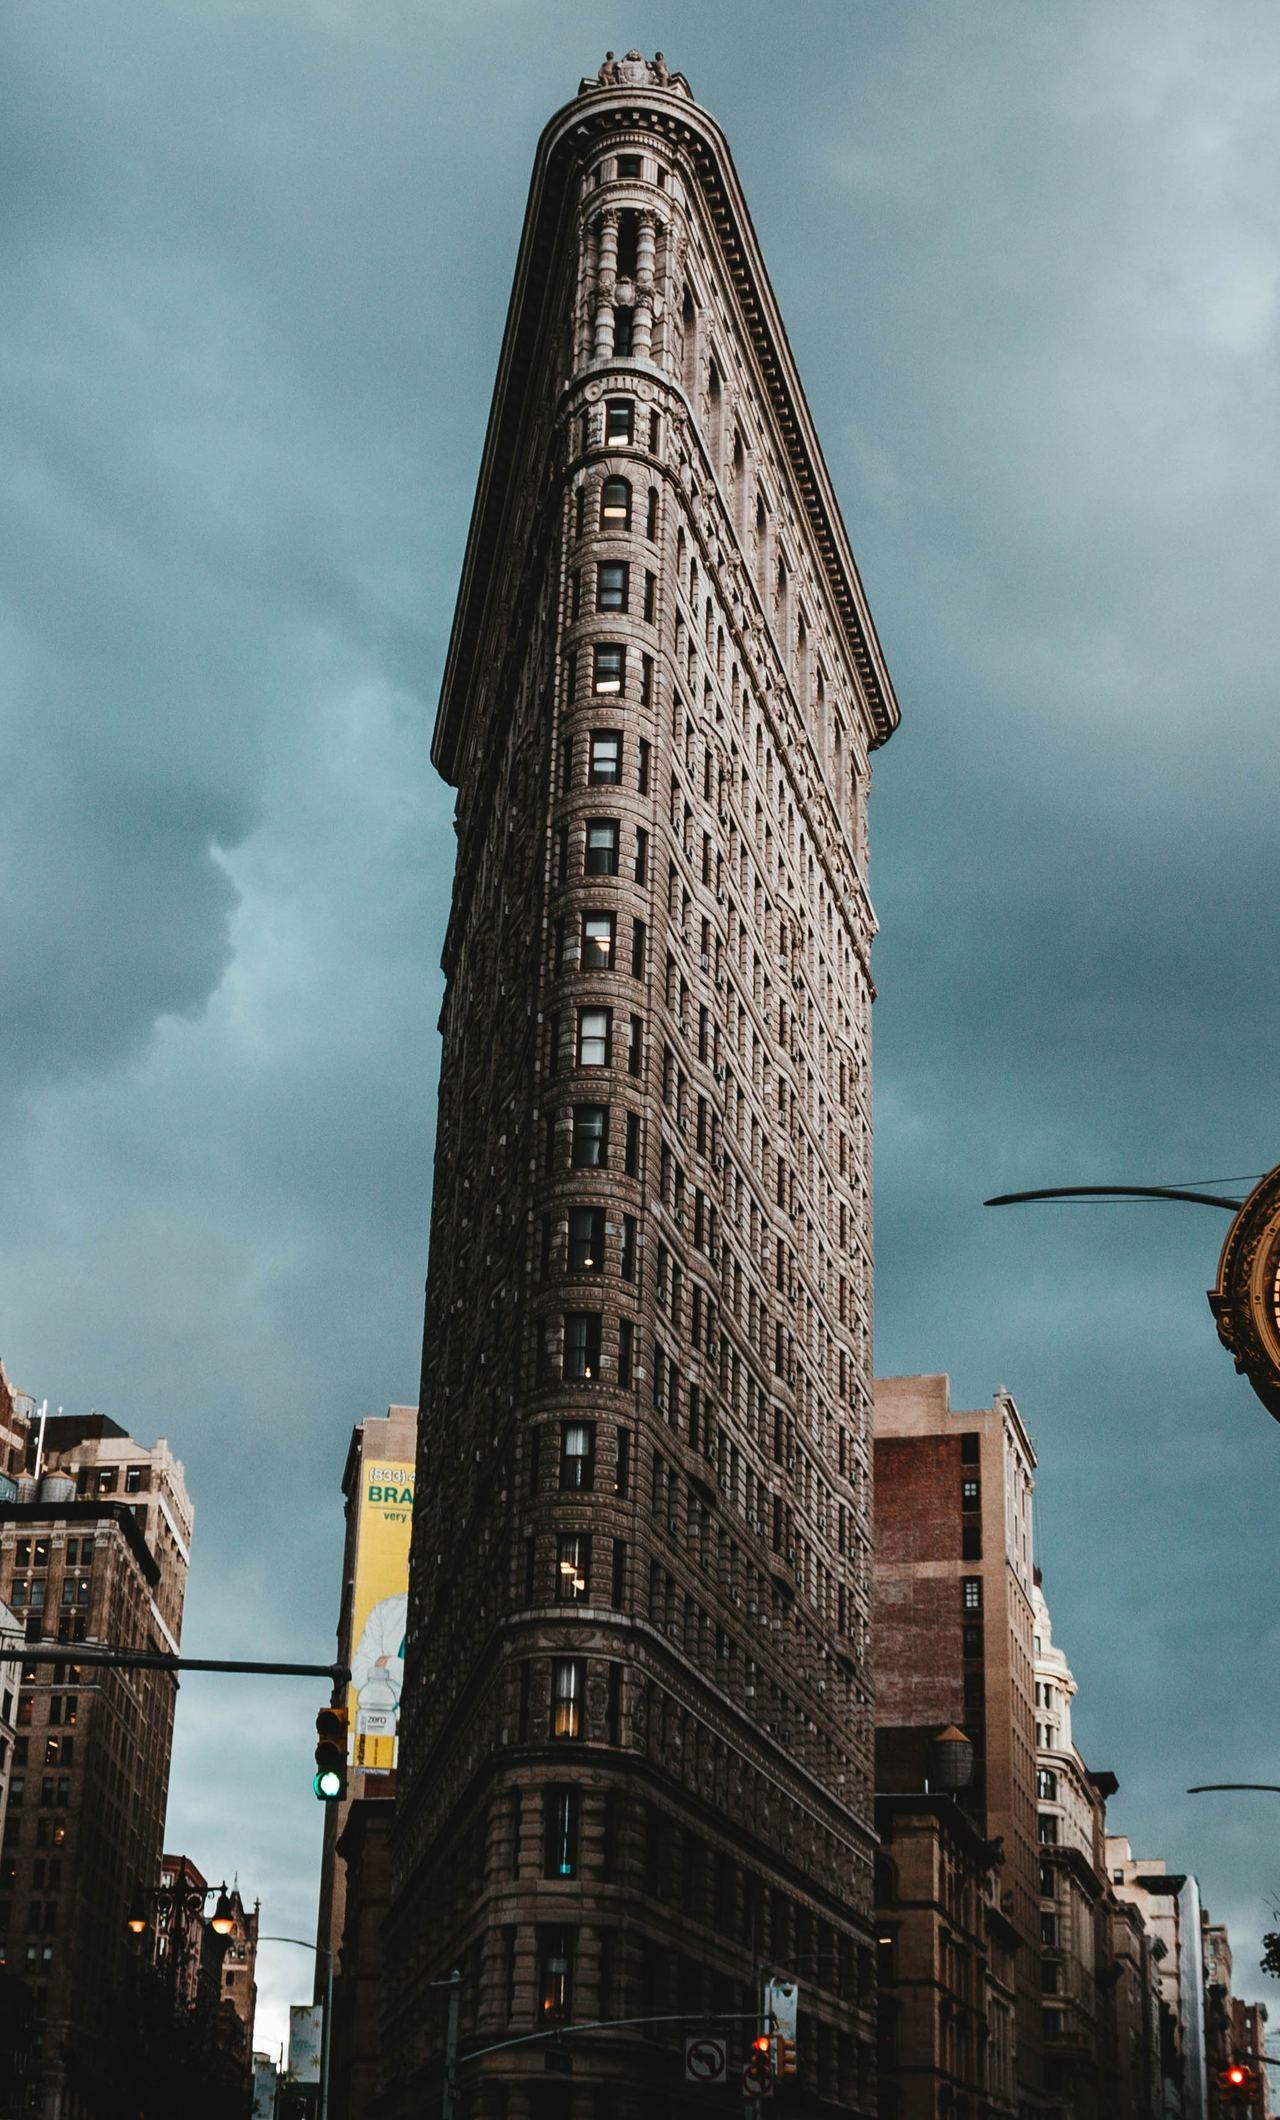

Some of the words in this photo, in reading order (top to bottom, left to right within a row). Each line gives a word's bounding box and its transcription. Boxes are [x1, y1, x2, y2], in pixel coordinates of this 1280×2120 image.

[369, 1486, 413, 1503] BRA
[384, 1513, 406, 1523] very
[368, 1716, 386, 1724] zero
